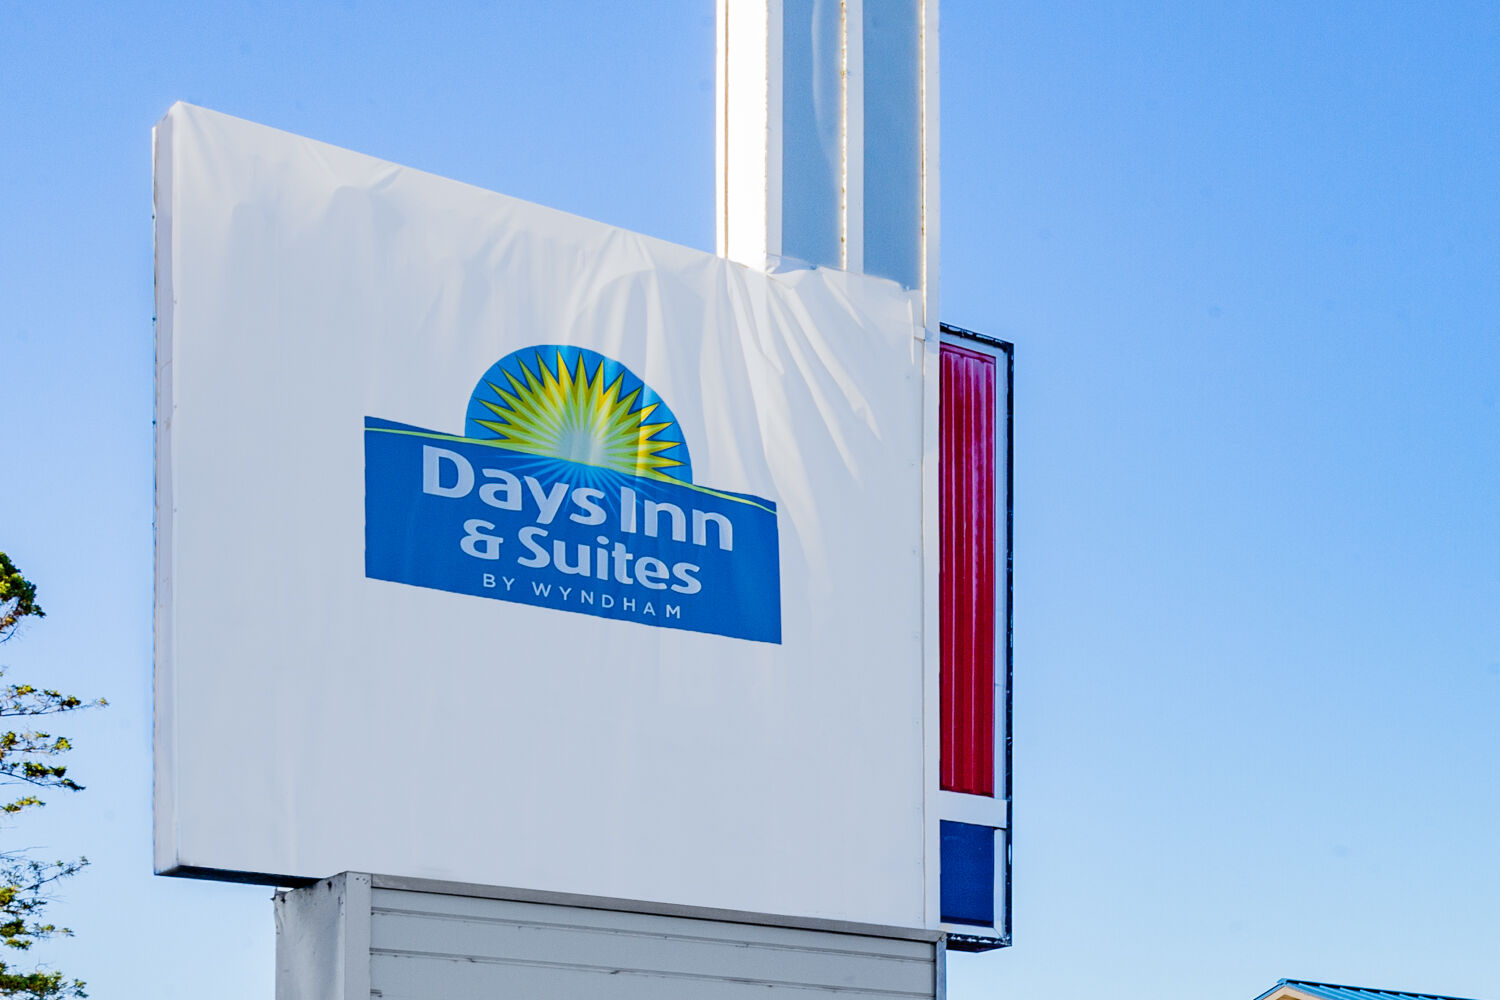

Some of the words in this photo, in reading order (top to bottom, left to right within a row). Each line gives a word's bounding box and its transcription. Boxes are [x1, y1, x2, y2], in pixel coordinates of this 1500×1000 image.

[423, 445, 607, 526] Days
[620, 486, 733, 552] Inn
[460, 519, 504, 560] &
[517, 526, 702, 595] Suites
[483, 573, 515, 591] BY
[532, 582, 681, 619] WYNDHAM
